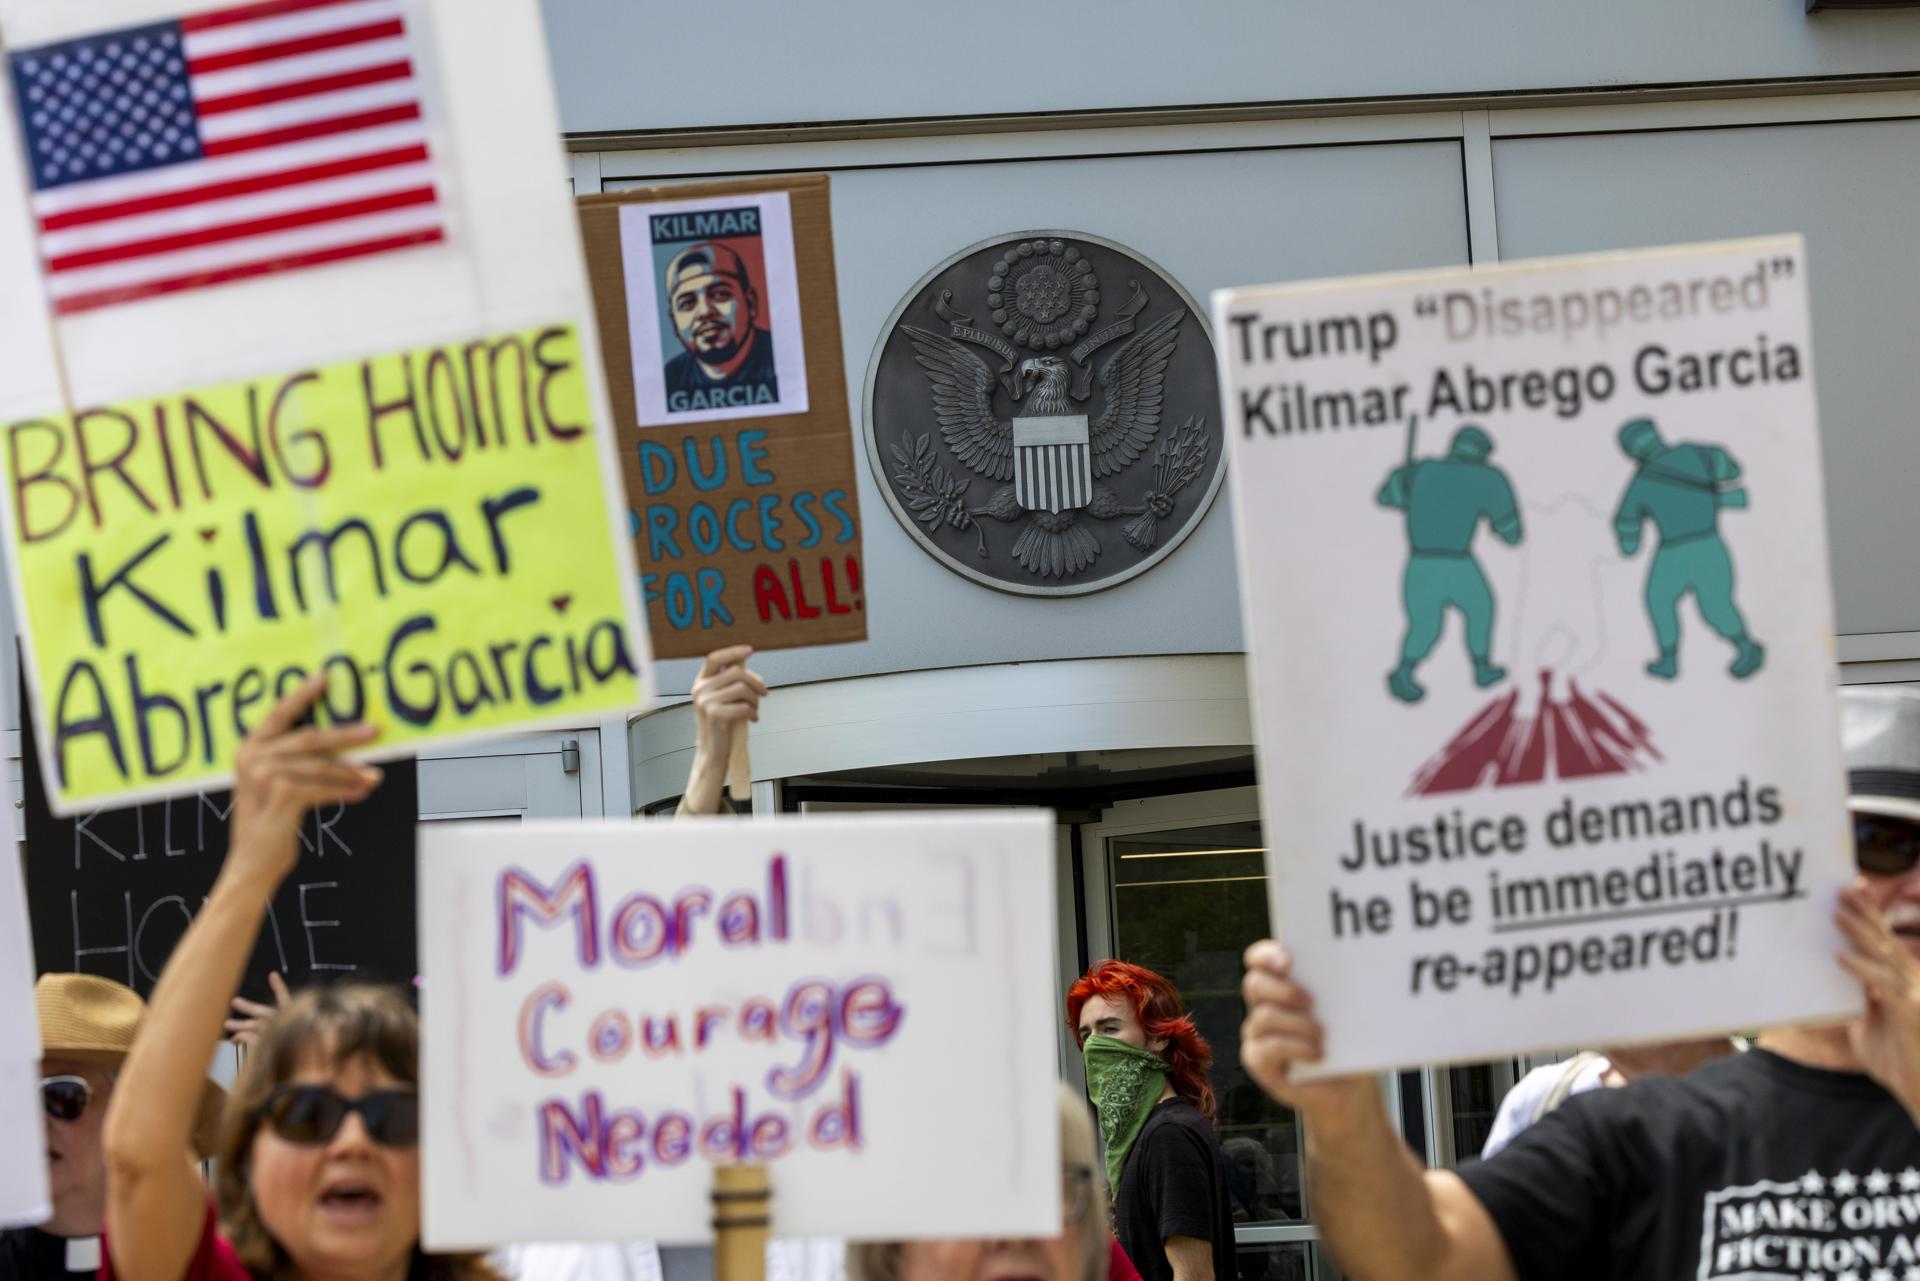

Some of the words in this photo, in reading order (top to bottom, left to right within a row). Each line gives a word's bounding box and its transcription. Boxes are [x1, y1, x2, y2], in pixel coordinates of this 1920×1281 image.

[653, 210, 758, 239] KILMAR
[953, 326, 961, 337] E
[962, 328, 1016, 360] PLURIBUS
[1229, 308, 1398, 366] Trump
[1415, 254, 1796, 343] “Disappeared”
[669, 383, 775, 412] GARCIA
[1239, 384, 1409, 440] Kilmar
[1427, 362, 1616, 420] Abrego
[1634, 335, 1802, 397] Garcia
[8, 372, 333, 543] BRING
[637, 429, 775, 496] DUE
[77, 485, 542, 648] Kilmar
[752, 554, 864, 624] ALL!
[74, 792, 353, 870] KILMR
[1340, 808, 1527, 873] Justice
[1545, 776, 1784, 847] demands
[496, 850, 791, 977] Moral
[1330, 887, 1391, 938] he
[1410, 880, 1472, 930] be
[1490, 840, 1806, 920] immediately
[1410, 908, 1741, 998] re-appeared!
[517, 975, 907, 1099] Courage
[538, 1065, 866, 1186] Needed
[1716, 1233, 1880, 1273] FICTION
[1887, 1231, 1920, 1267] A
[1720, 1197, 1837, 1238] MAKE
